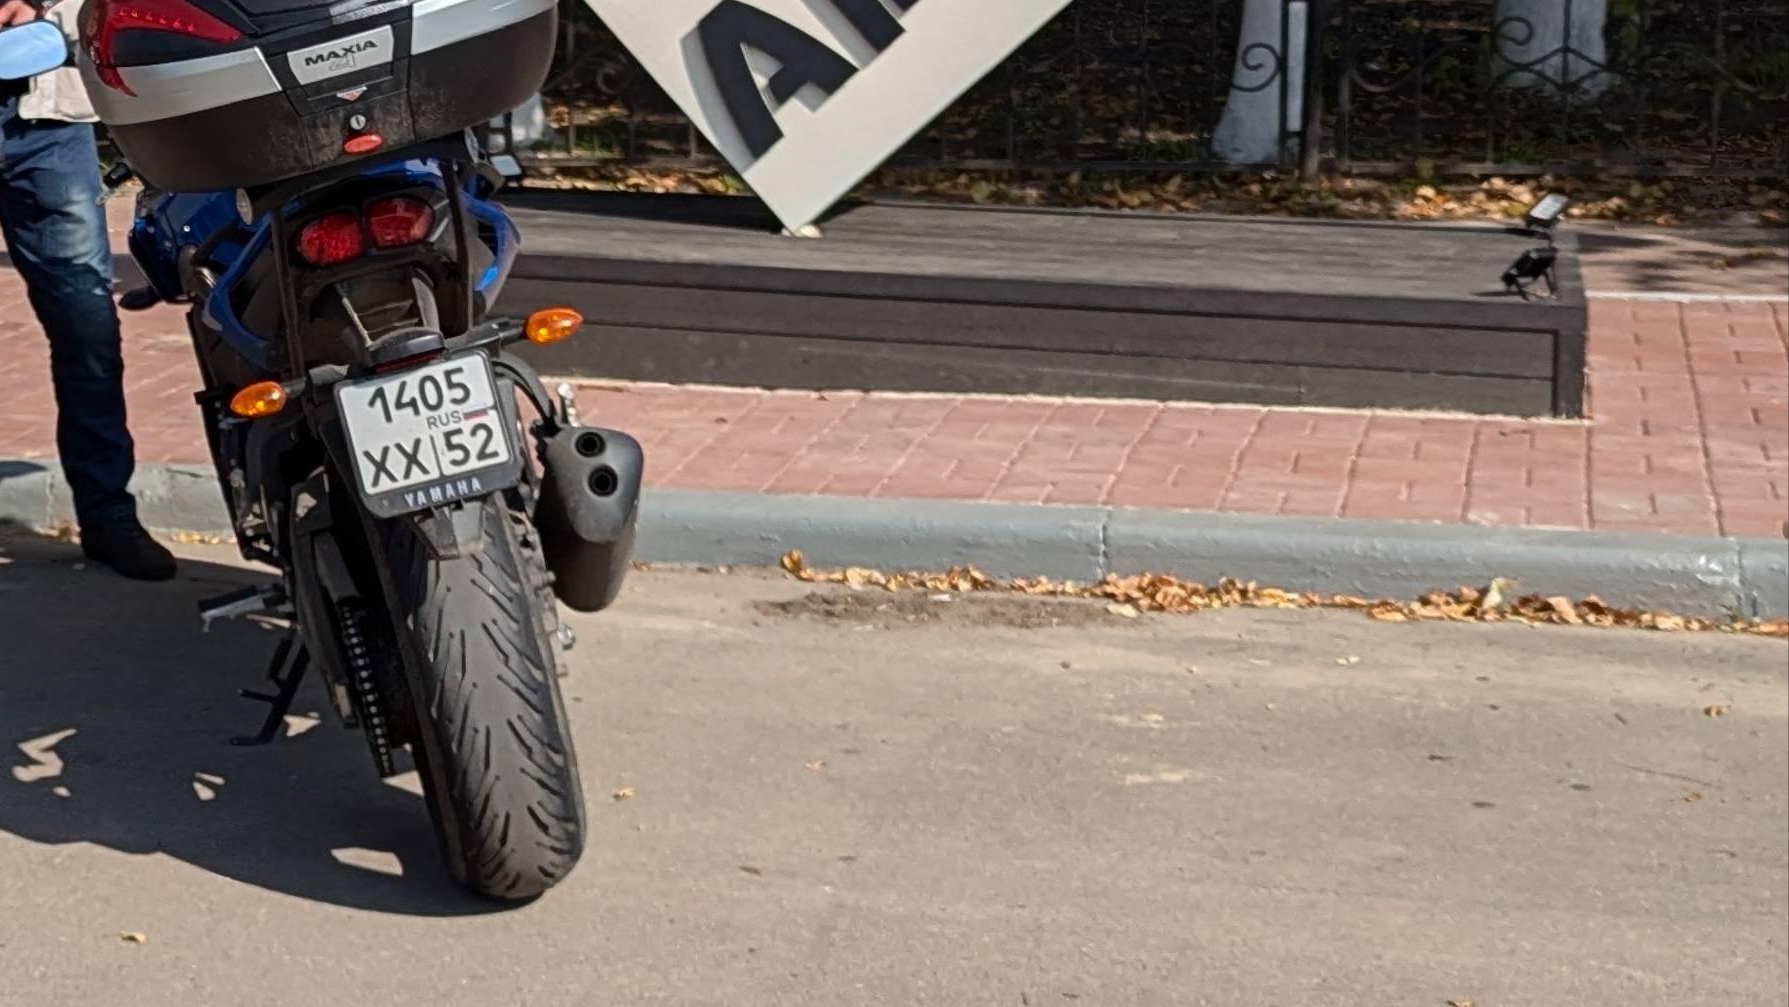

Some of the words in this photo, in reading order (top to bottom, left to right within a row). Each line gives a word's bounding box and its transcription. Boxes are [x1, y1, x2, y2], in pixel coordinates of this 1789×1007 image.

[304, 40, 378, 67] MAXIA
[367, 366, 471, 423] 1405
[426, 411, 462, 430] RUS
[443, 423, 500, 467] 52
[404, 477, 482, 507] YAMAHA
